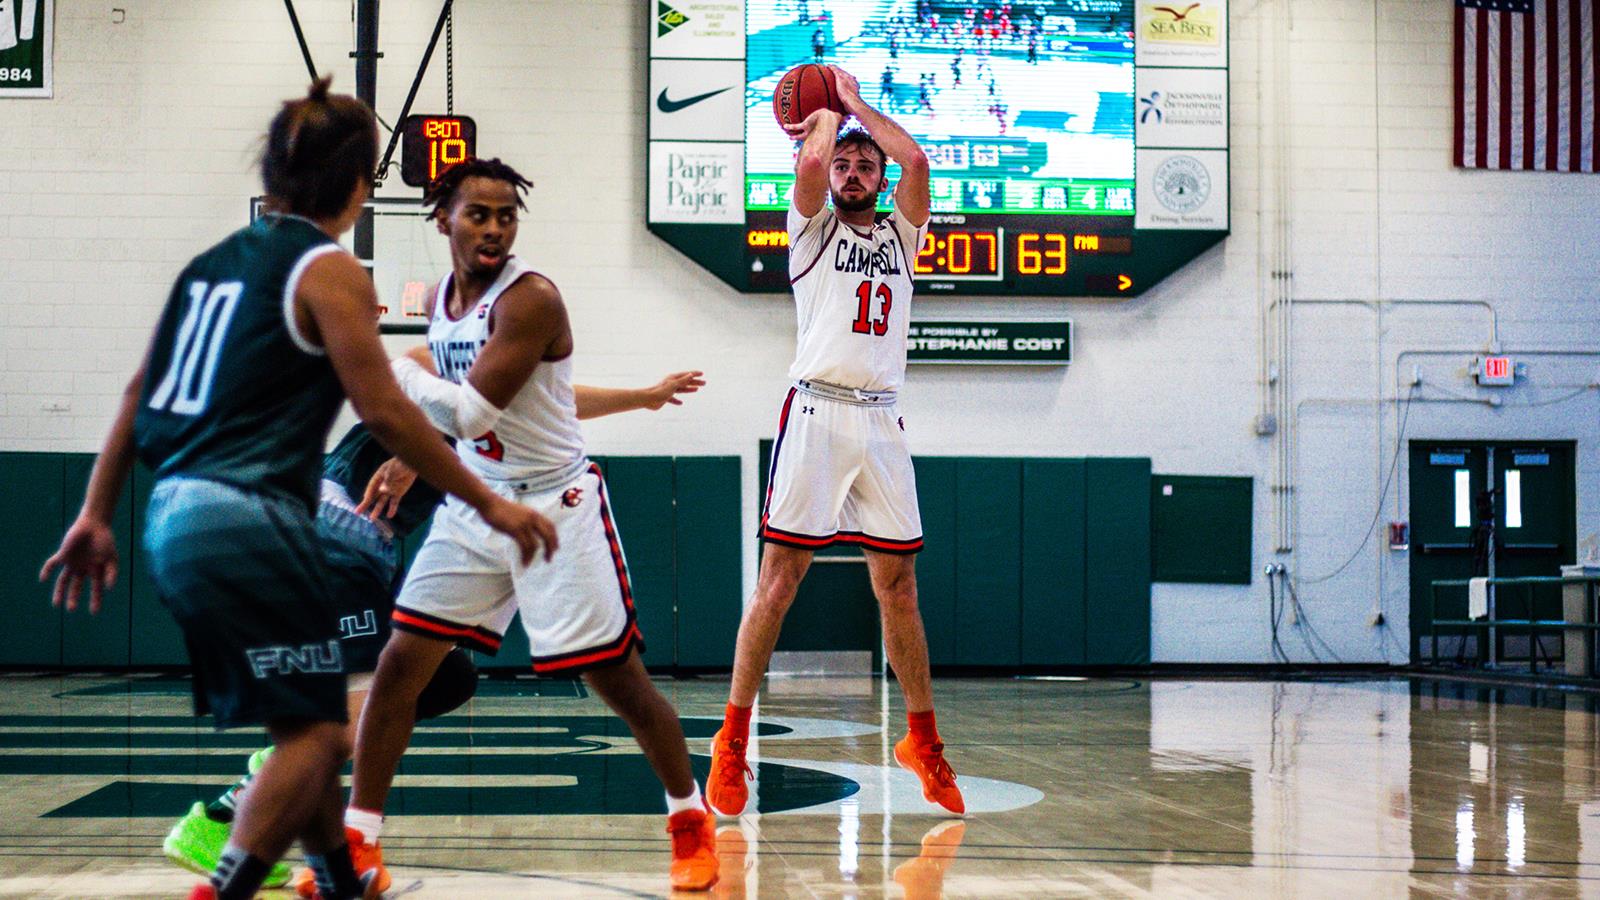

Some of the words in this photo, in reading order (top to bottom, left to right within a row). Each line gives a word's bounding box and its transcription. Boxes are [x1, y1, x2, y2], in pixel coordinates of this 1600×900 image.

[425, 121, 461, 139] 12:07
[1018, 234, 1067, 274] 63
[852, 280, 893, 336] 13
[148, 281, 244, 415] 10
[1486, 357, 1510, 378] EXIT
[246, 640, 342, 678] FNU
